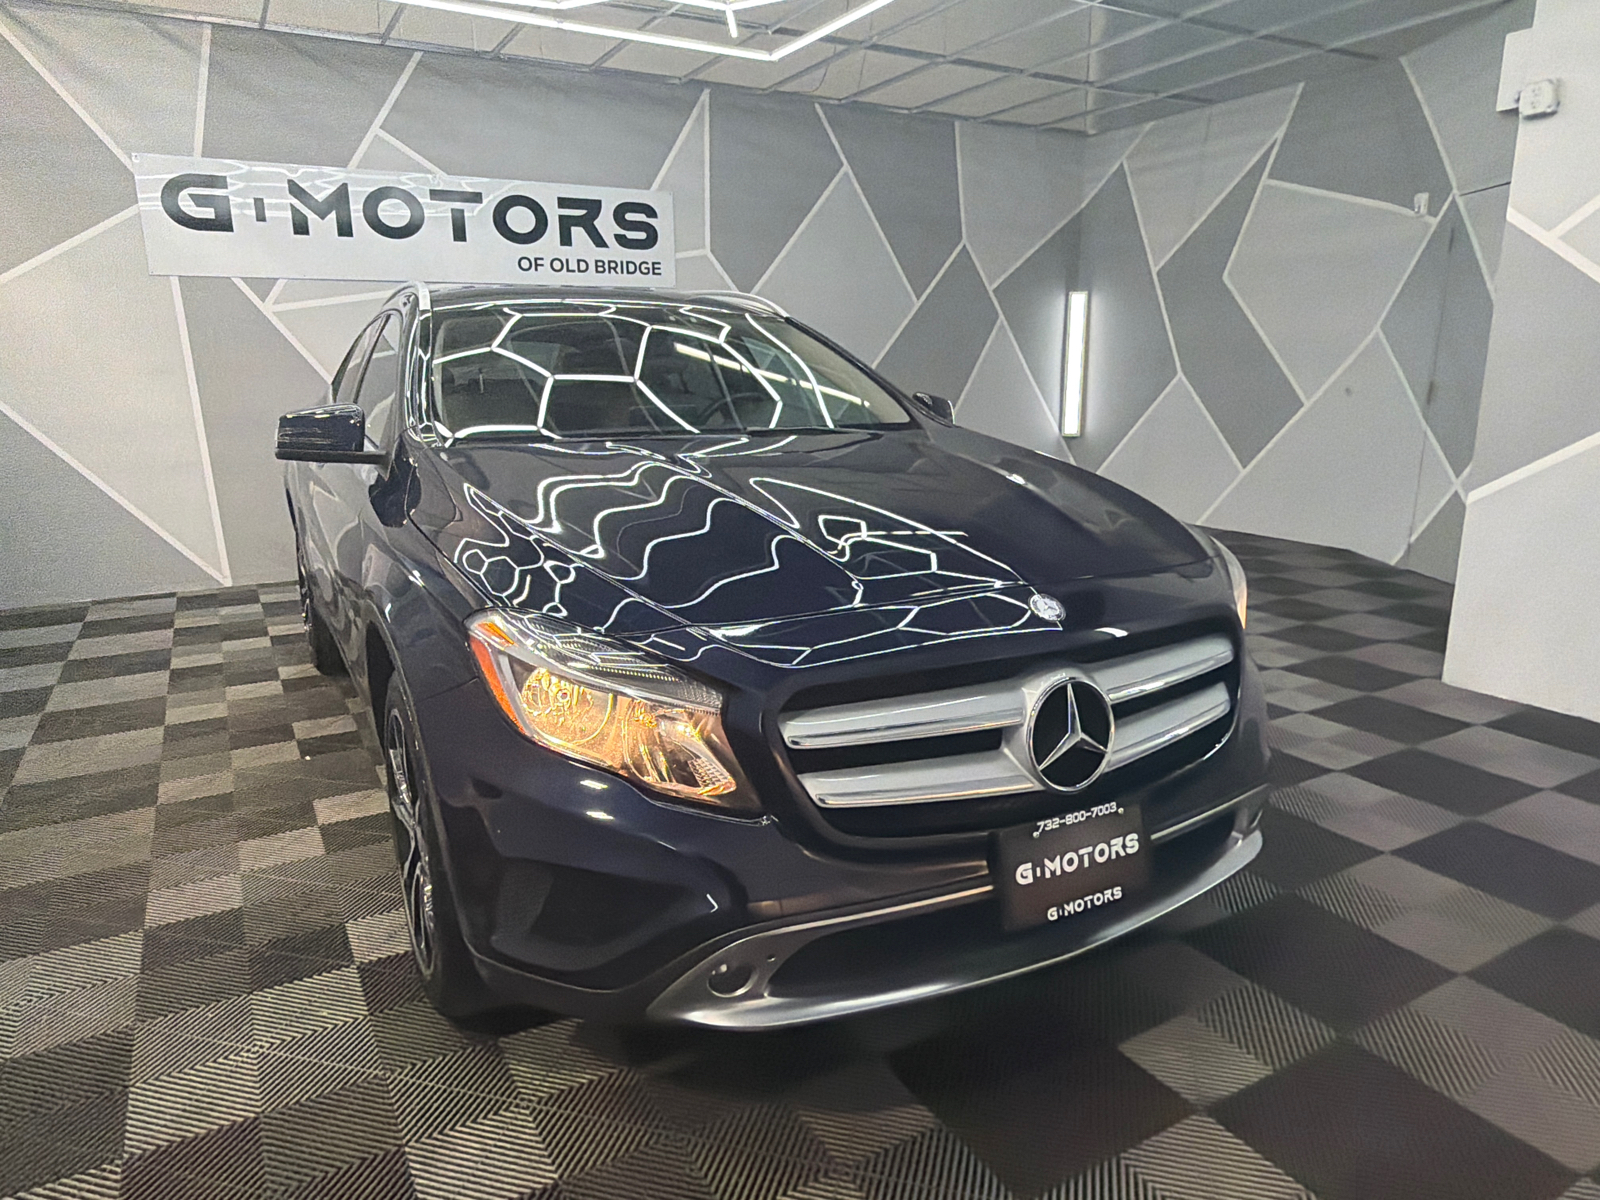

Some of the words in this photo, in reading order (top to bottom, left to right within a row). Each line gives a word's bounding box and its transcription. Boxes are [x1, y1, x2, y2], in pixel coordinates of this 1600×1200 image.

[517, 256, 545, 273] OF
[549, 257, 590, 274] OLD
[594, 259, 662, 276] BRIDGE
[1036, 801, 1117, 833] 732-800-7003
